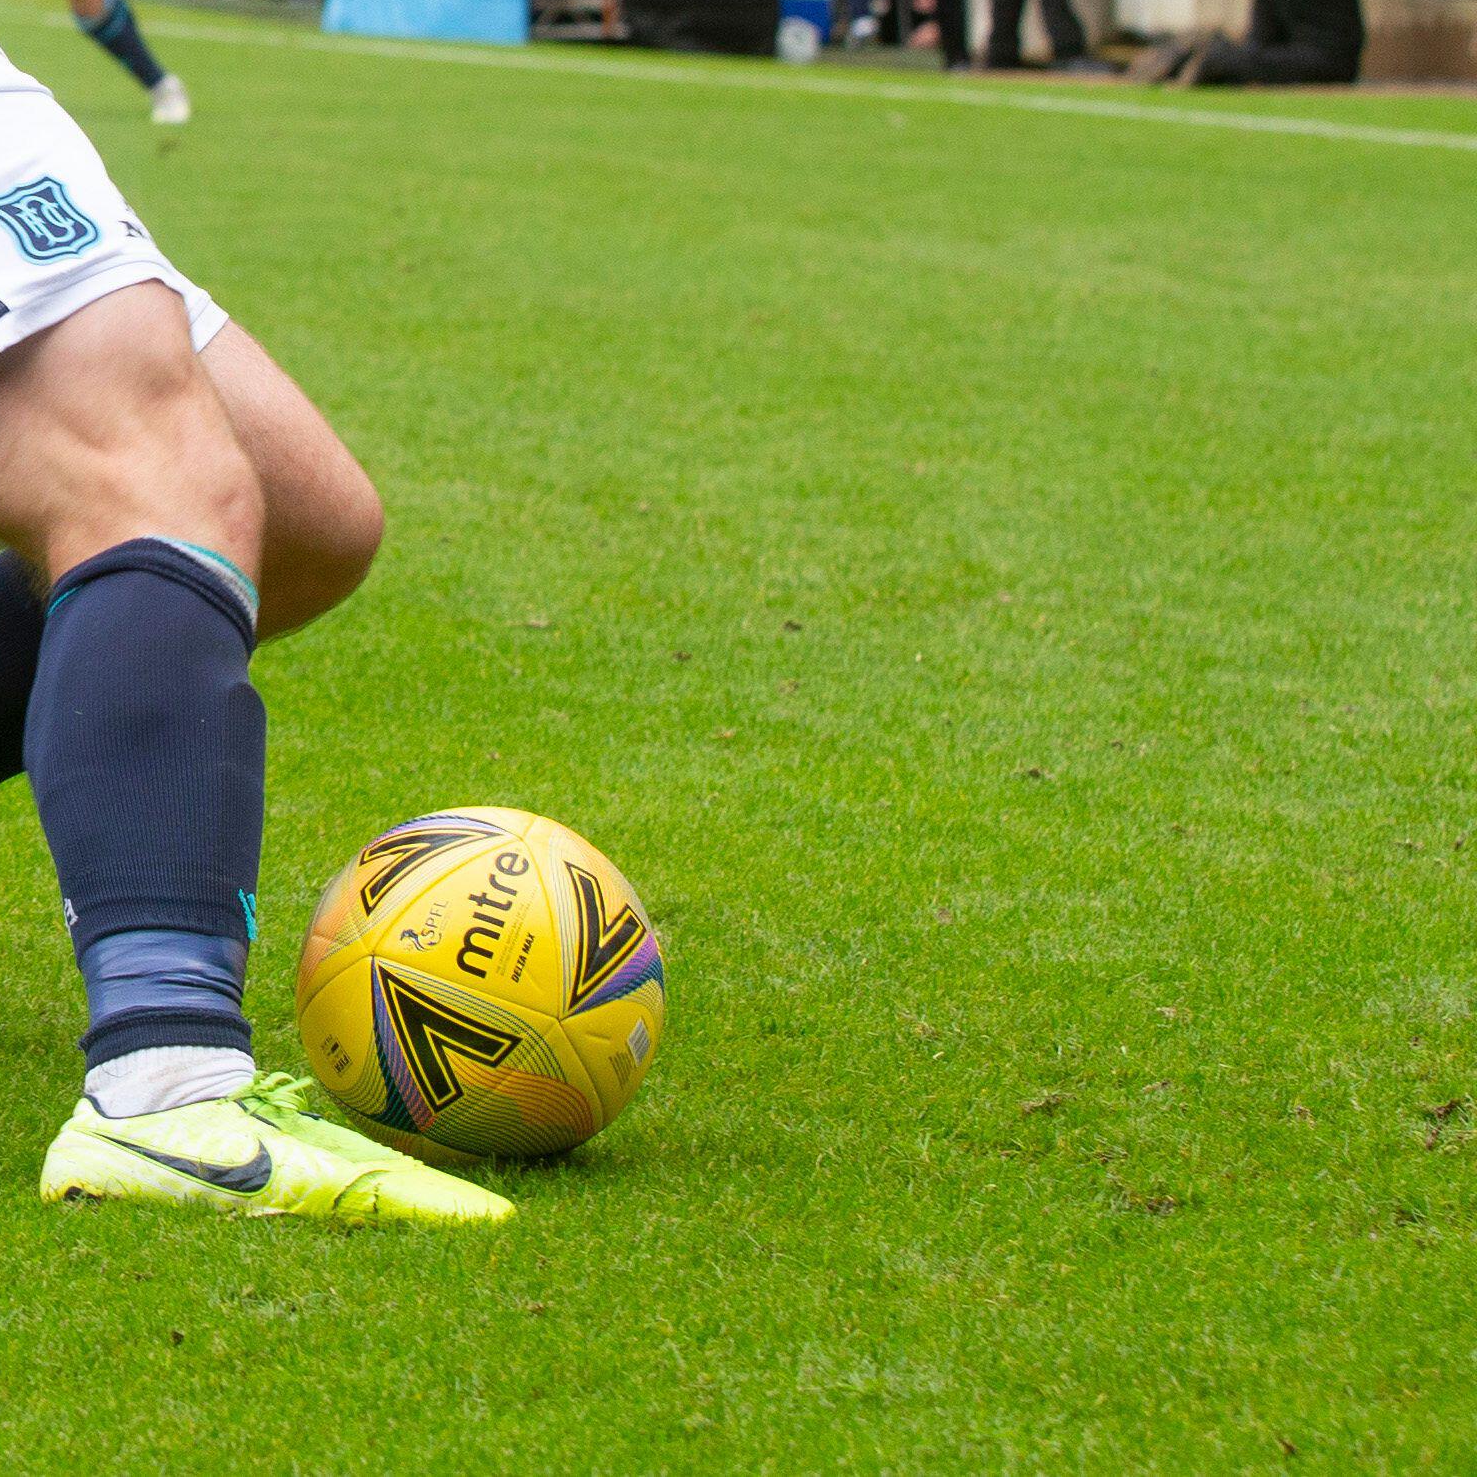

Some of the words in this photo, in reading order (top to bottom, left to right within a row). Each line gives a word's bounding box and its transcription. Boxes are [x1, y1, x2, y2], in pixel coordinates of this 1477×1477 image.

[420, 900, 449, 938] SPFL
[456, 852, 530, 979] mitre
[511, 955, 527, 983] DELTA
[522, 932, 535, 954] MAX
